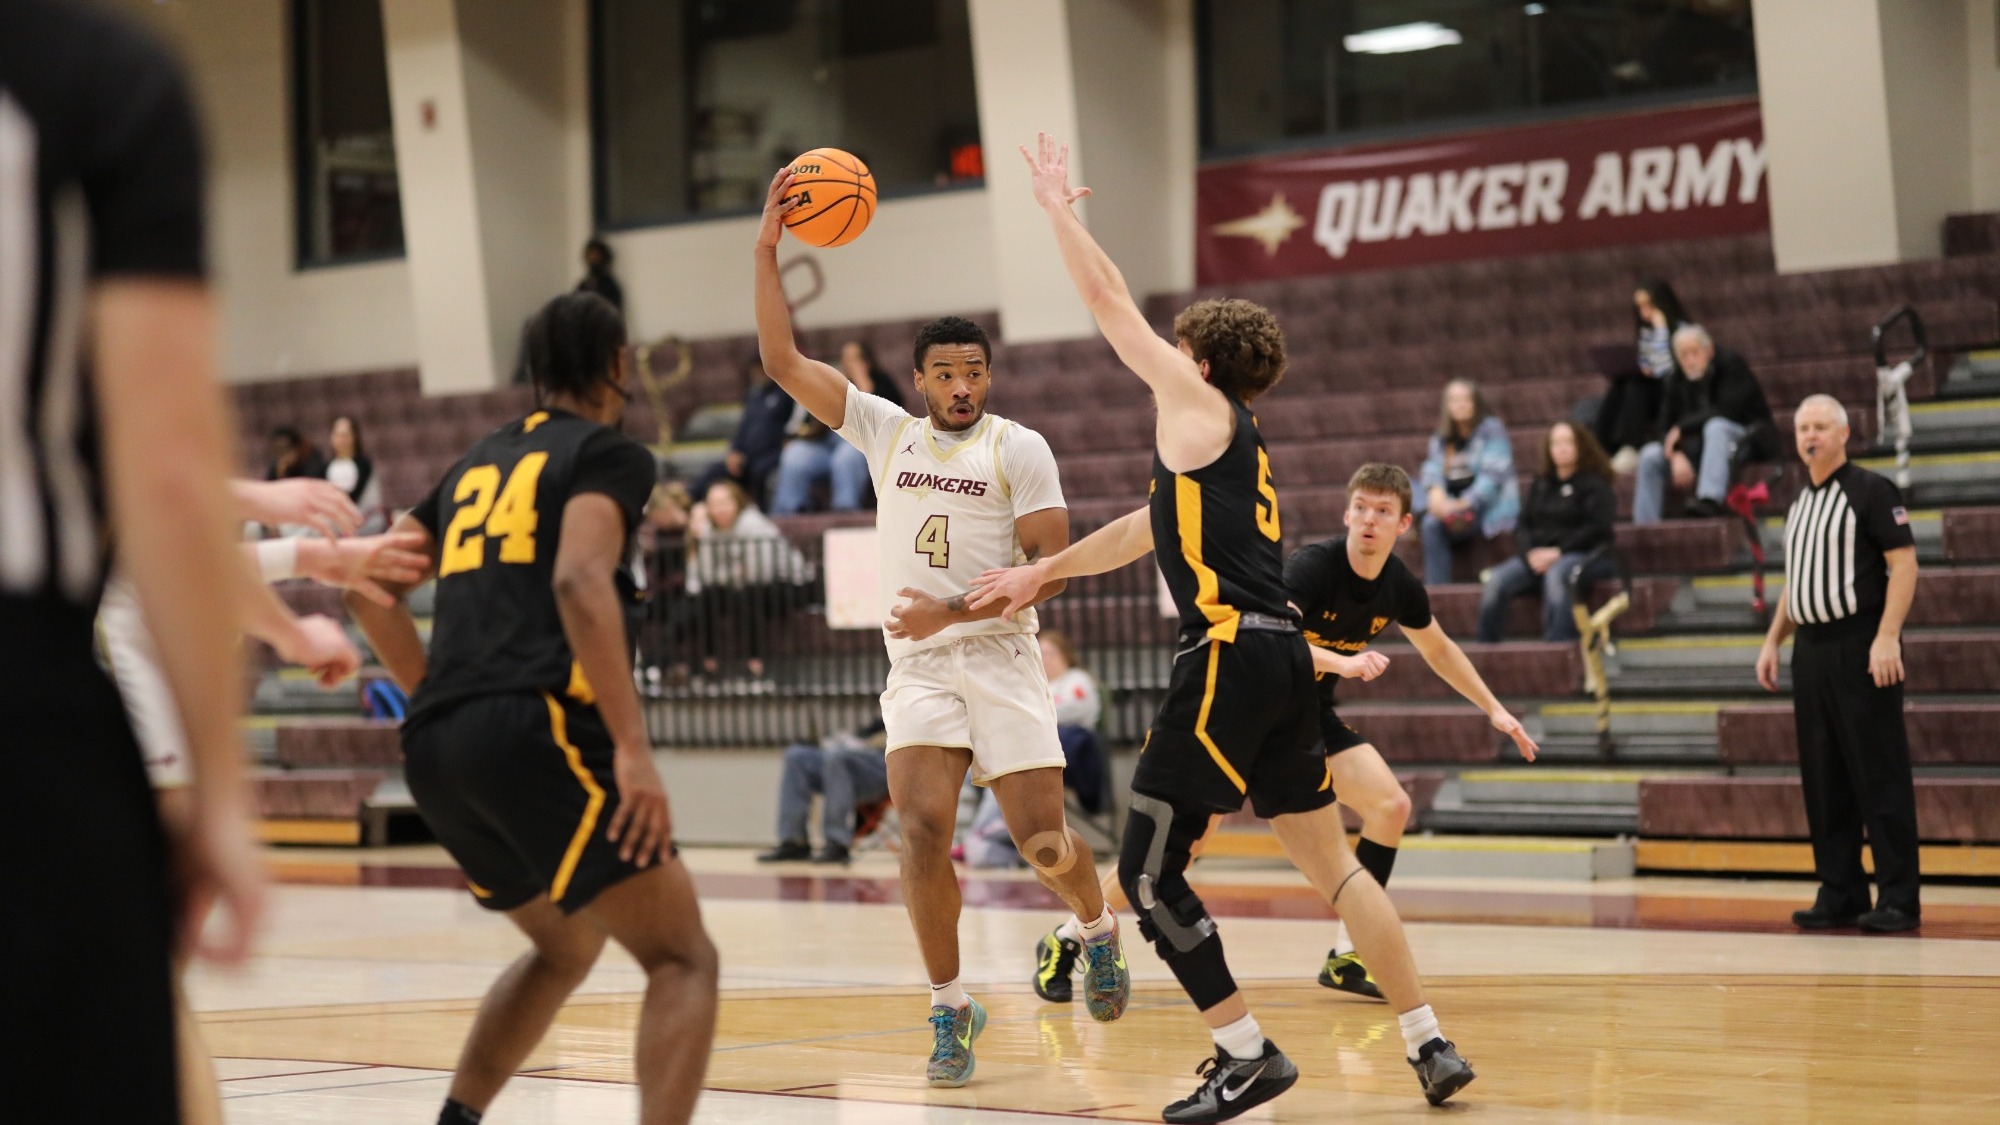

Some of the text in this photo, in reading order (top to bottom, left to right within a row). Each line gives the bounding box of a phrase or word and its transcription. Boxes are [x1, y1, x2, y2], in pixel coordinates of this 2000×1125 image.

[790, 163, 822, 175] son
[1313, 138, 1769, 260] QUAKER ARMY
[438, 451, 549, 579] 24
[896, 471, 988, 497] QUAKERS
[1255, 445, 1281, 543] 5
[915, 514, 949, 569] 4
